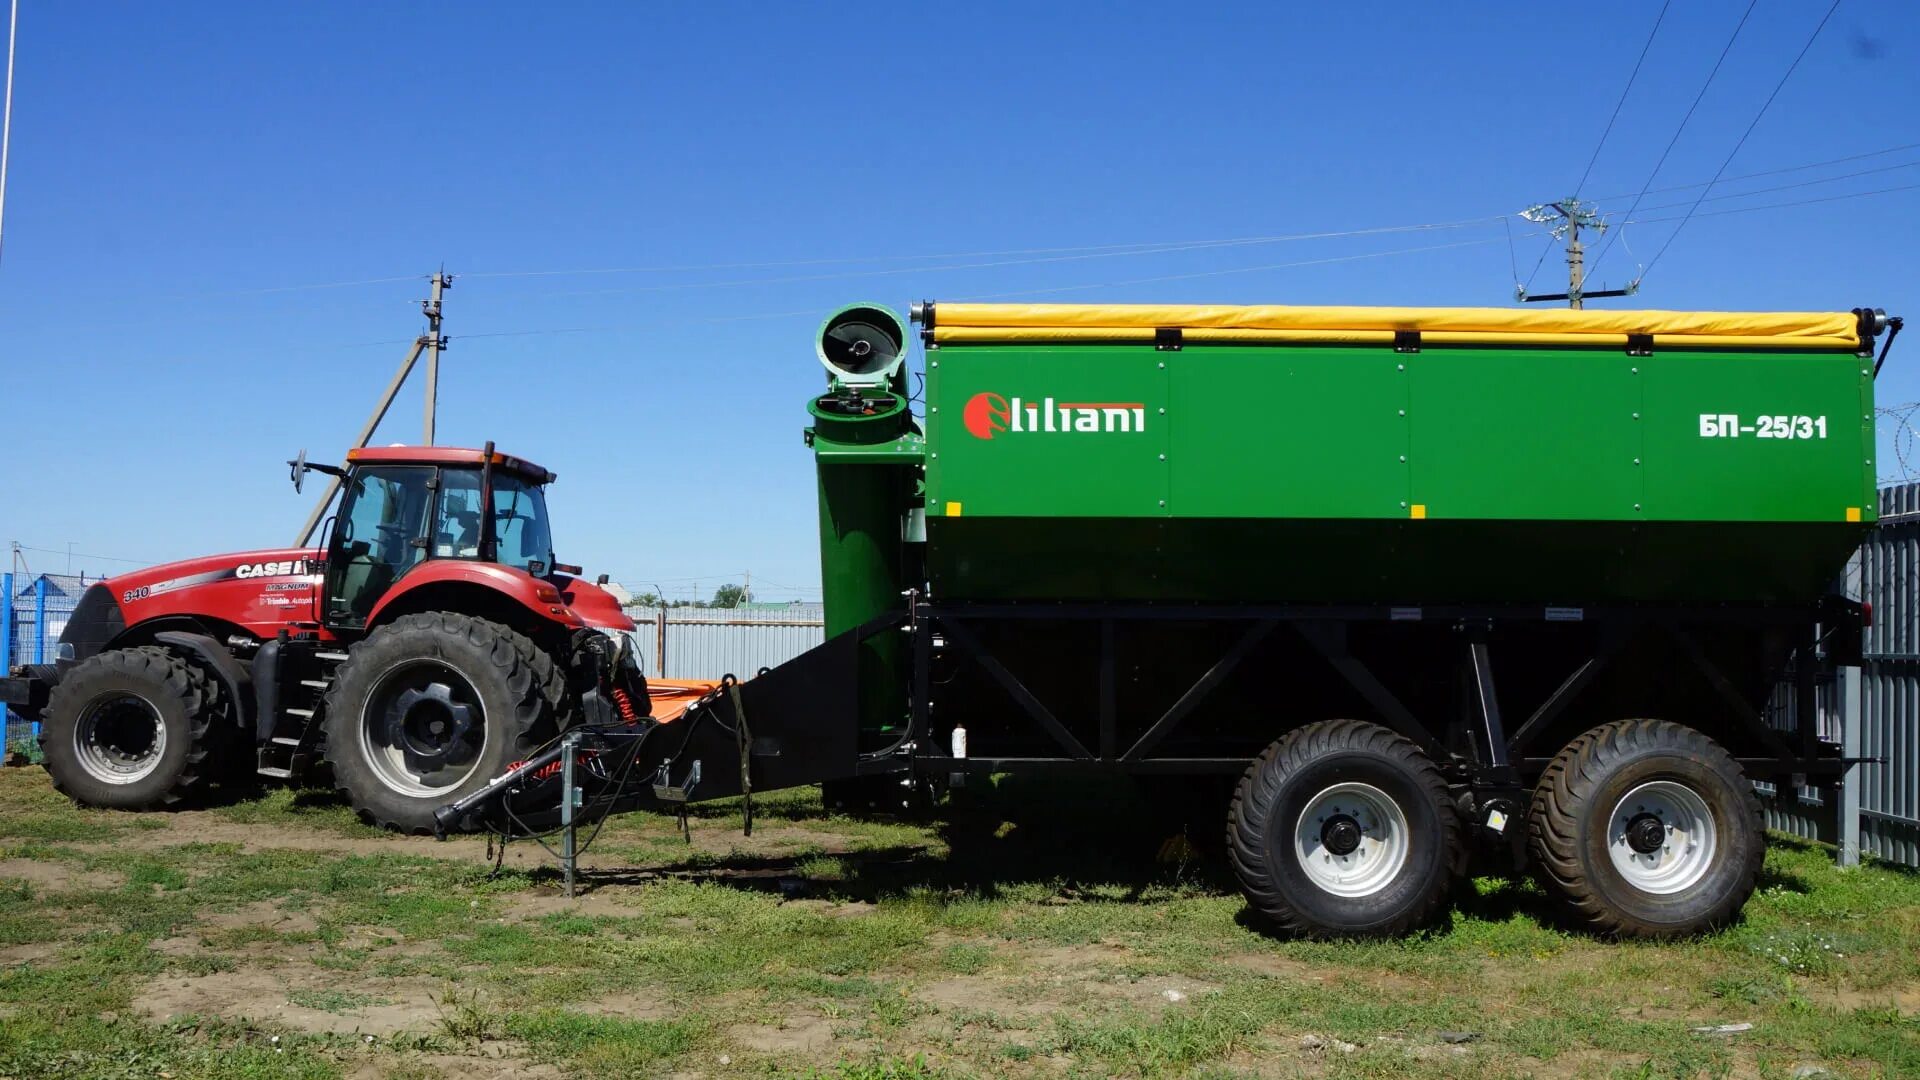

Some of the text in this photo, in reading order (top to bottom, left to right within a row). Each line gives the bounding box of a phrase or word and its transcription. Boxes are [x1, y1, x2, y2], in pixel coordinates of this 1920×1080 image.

[1011, 397, 1145, 432] liliani
[236, 561, 292, 579] CASE
[124, 585, 150, 603] 340
[265, 583, 309, 591] MAGNUM
[266, 597, 290, 606] Trimble
